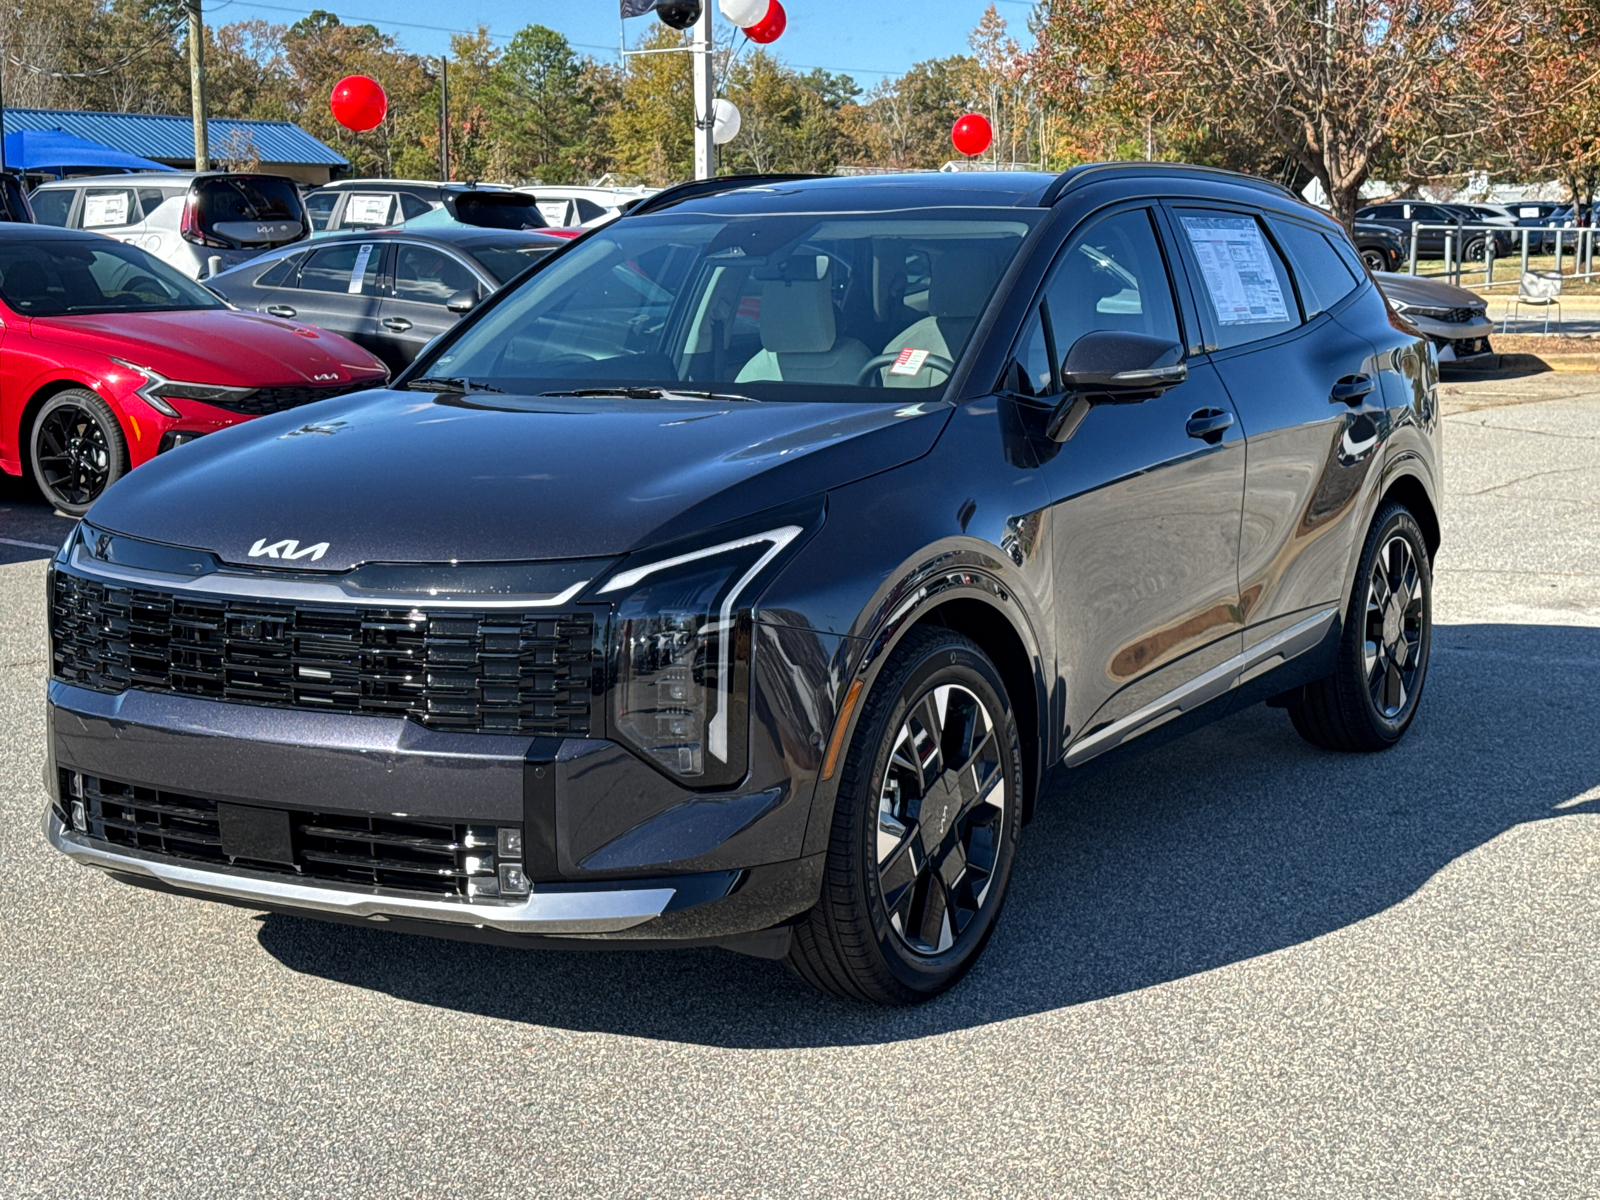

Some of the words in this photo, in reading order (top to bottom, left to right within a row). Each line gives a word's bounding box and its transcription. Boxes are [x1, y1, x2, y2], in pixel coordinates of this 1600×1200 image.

[247, 537, 330, 561] KIA
[1012, 748, 1021, 841] MICHELIN
[867, 792, 878, 897] MICHELIN
